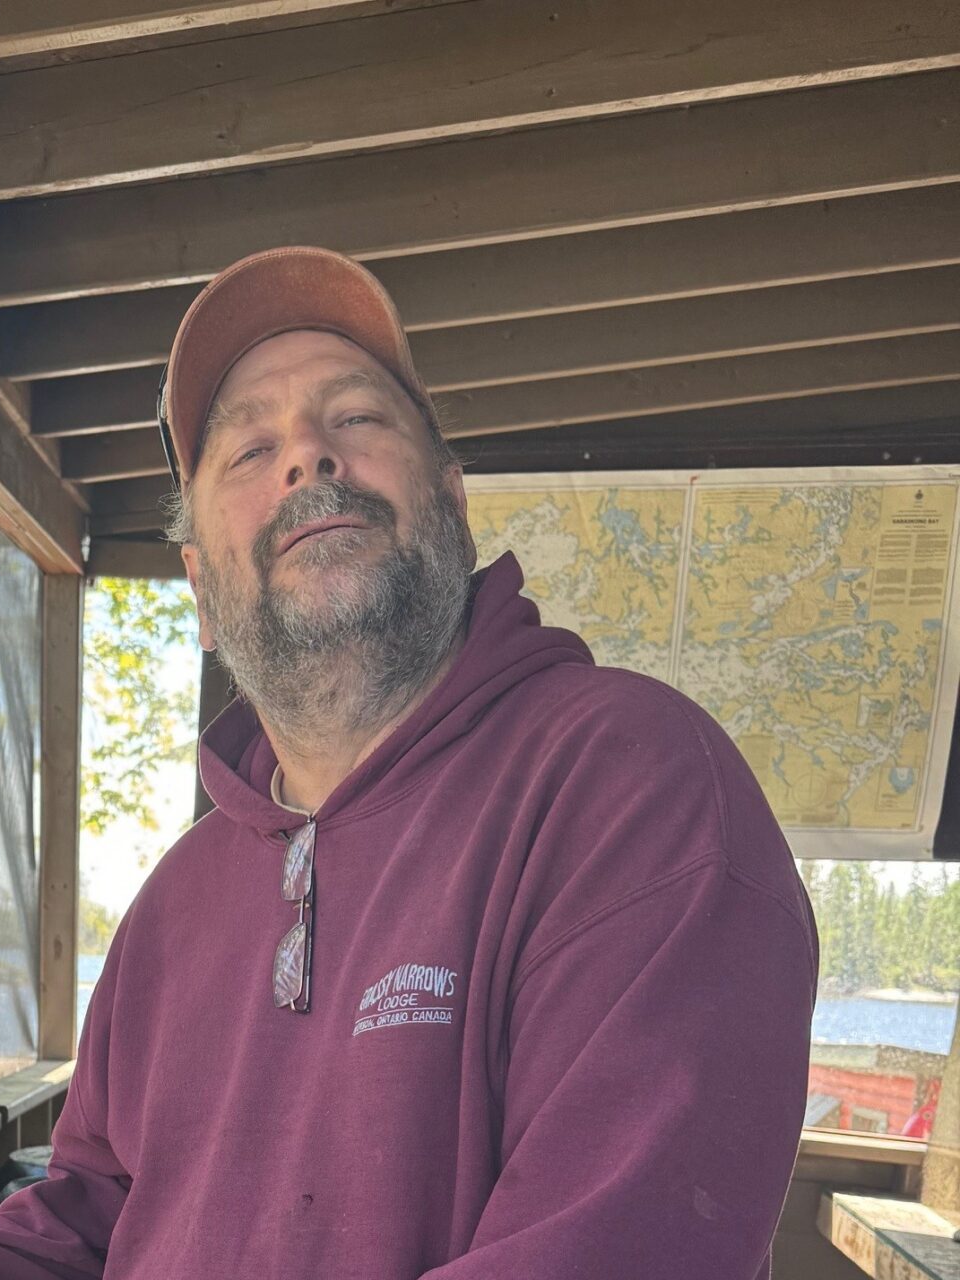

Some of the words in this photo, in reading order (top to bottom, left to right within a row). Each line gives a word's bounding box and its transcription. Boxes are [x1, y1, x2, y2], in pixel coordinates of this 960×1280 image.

[392, 963, 457, 998] NARROWS
[377, 993, 419, 1011] LODGE
[377, 1012, 408, 1025] ONTARIO
[412, 1010, 452, 1021] CANADA
